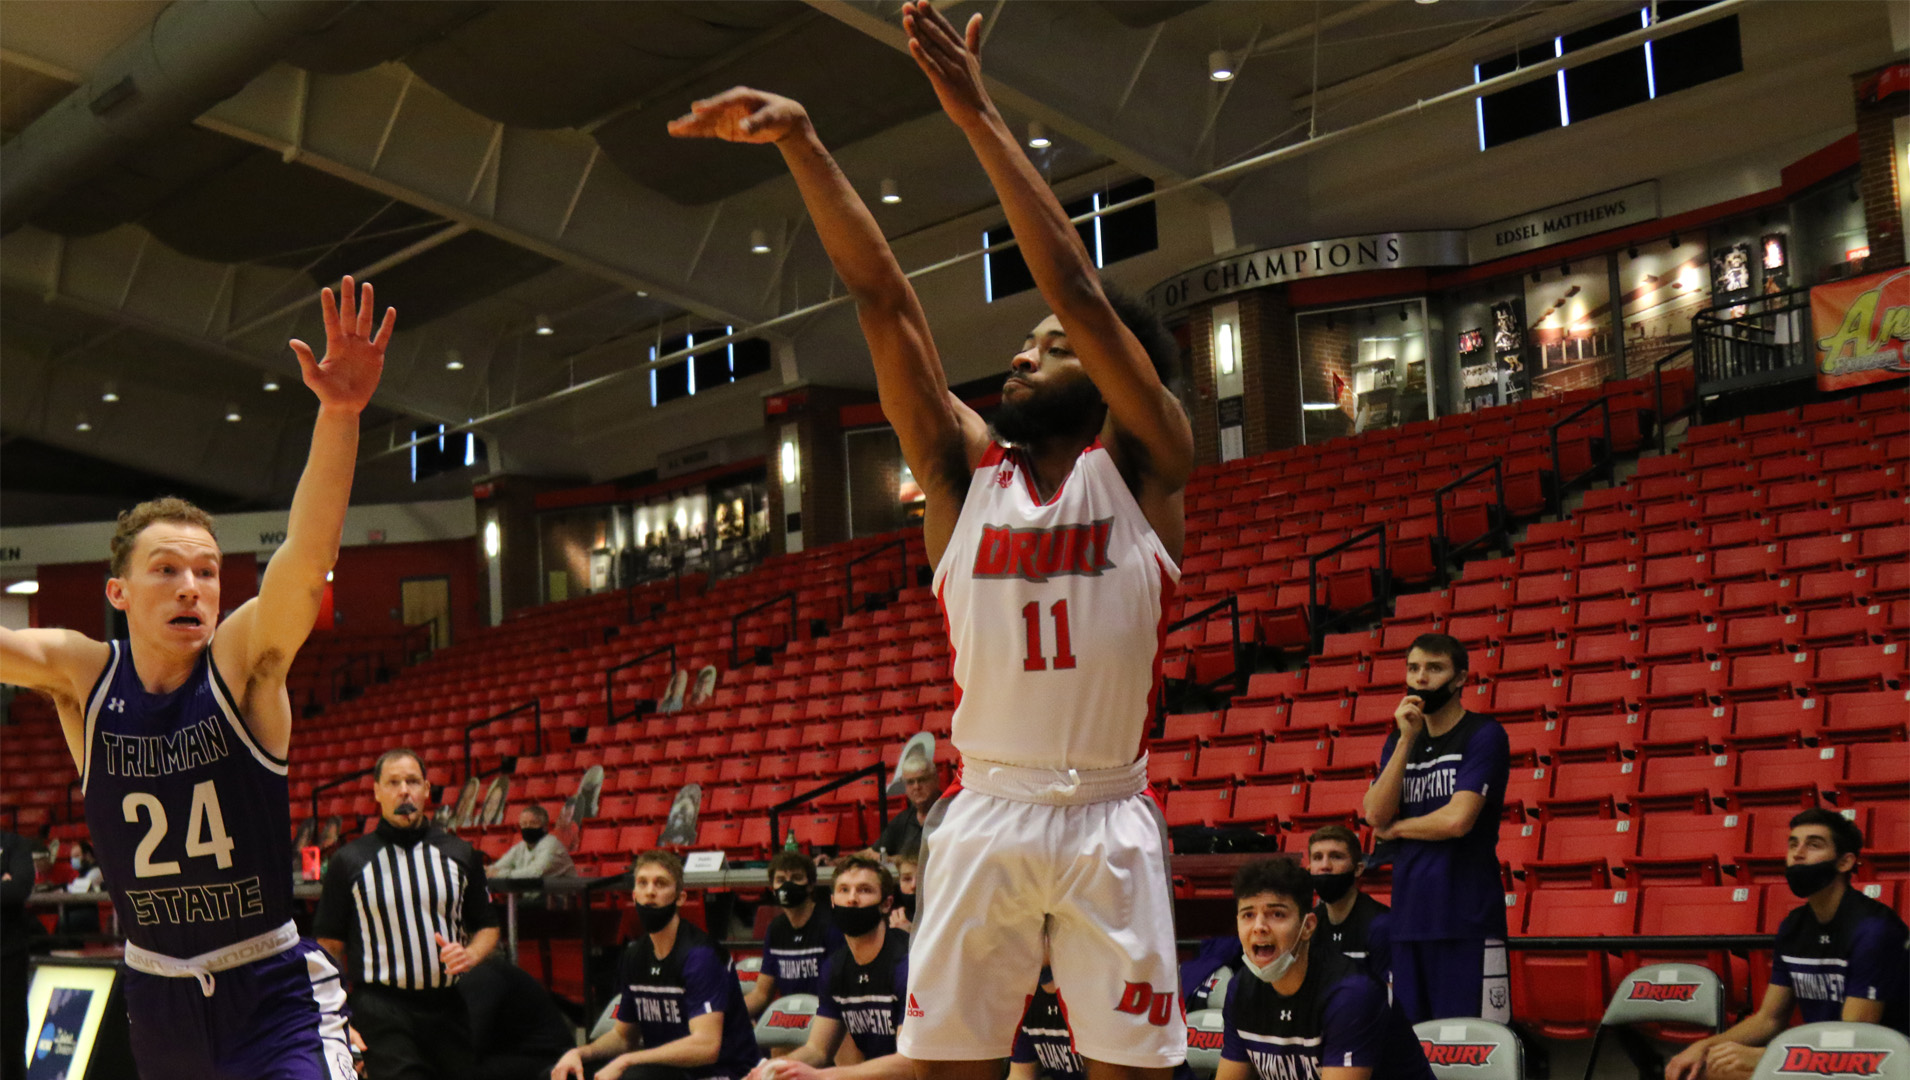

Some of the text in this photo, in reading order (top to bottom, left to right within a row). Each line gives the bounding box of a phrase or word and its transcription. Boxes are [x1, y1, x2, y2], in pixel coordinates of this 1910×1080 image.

[1495, 200, 1627, 247] EDSEL MATTHEWS
[1165, 238, 1400, 307] OF CHAMPIONS
[1022, 599, 1076, 671] 11
[101, 715, 229, 778] TRUMAN
[121, 779, 235, 879] 24
[126, 876, 265, 926] STATE
[1113, 979, 1174, 1028] DU
[1628, 980, 1702, 1002] DRURY
[1776, 1045, 1892, 1076] DRURY
